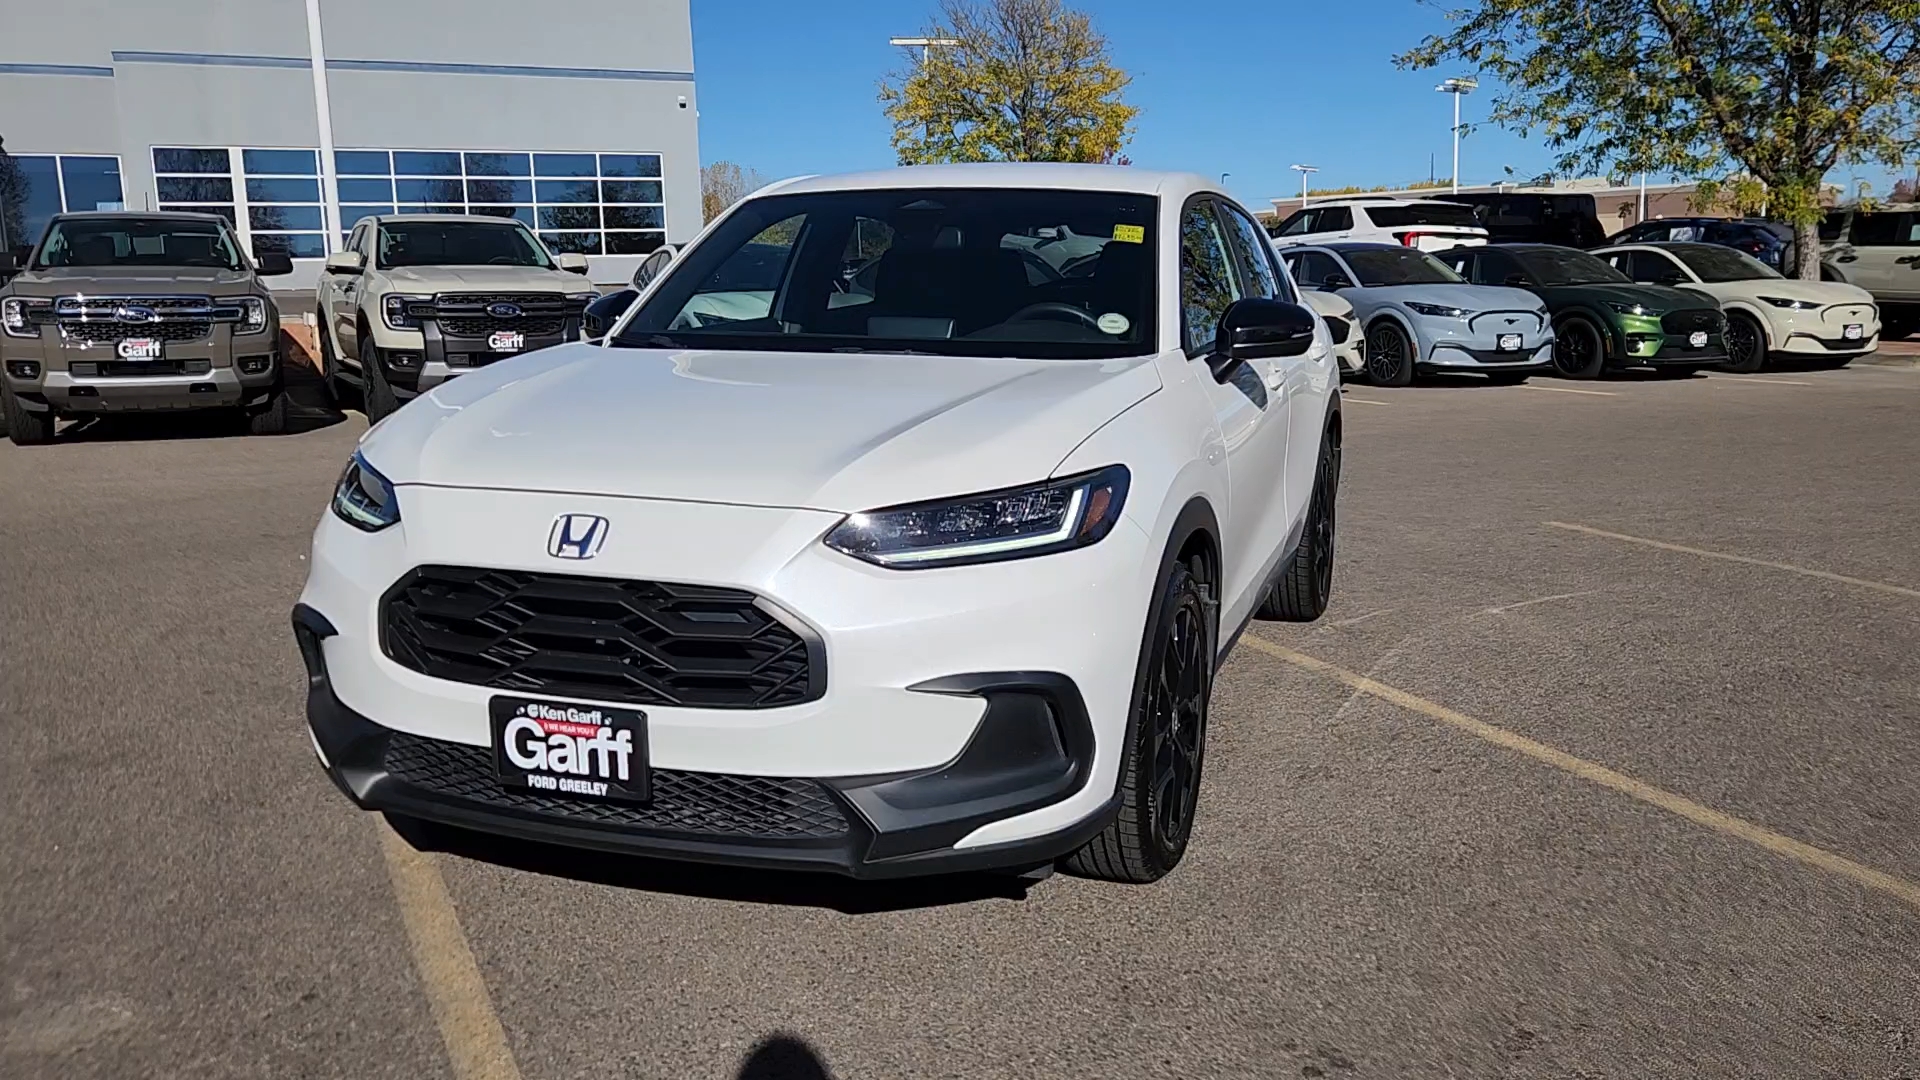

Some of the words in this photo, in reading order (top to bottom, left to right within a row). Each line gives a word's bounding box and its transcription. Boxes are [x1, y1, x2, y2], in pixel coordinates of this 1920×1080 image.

[118, 341, 161, 357] Garff
[488, 334, 524, 348] Garff
[539, 705, 566, 722] Ken
[566, 708, 602, 725] Garff
[560, 725, 576, 733] HEAR
[504, 717, 633, 780] Garff
[527, 774, 556, 790] FORD
[559, 778, 608, 796] GREELEY
